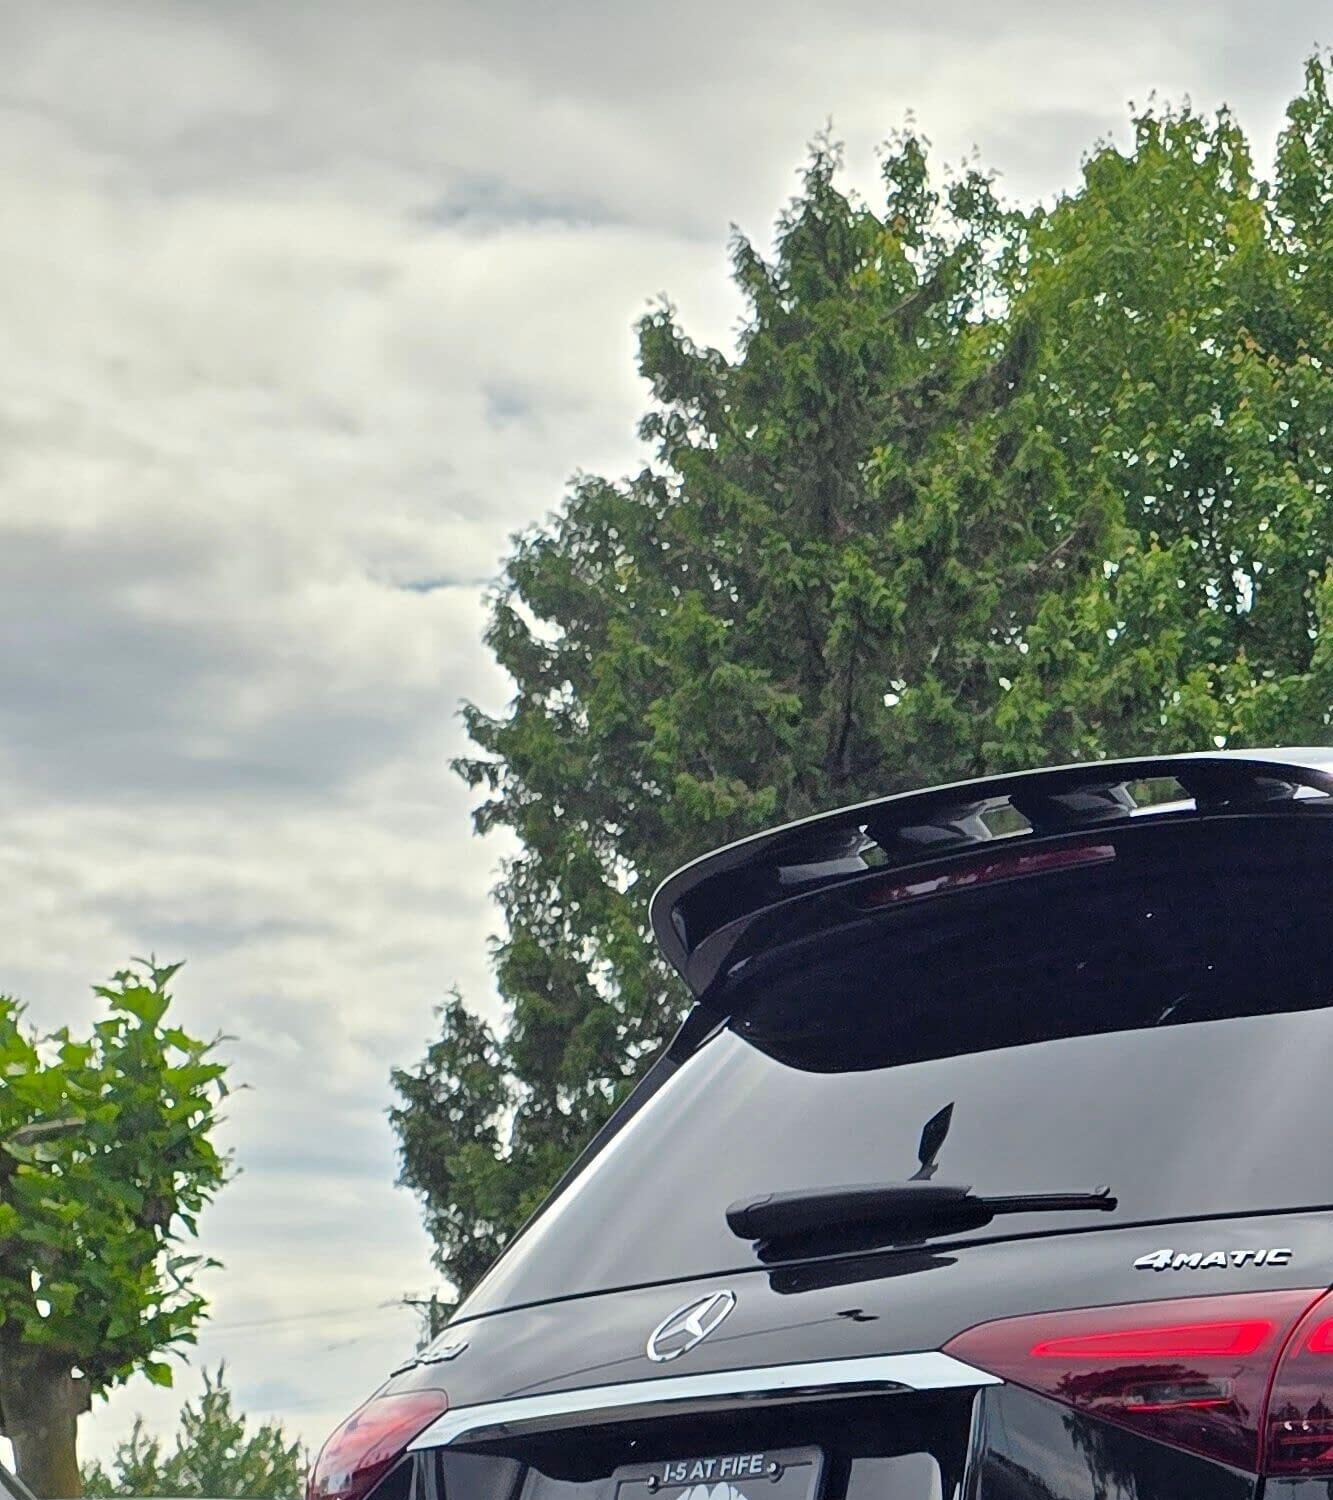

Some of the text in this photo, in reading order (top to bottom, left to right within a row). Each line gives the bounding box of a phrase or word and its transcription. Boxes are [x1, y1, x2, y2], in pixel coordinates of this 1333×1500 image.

[1133, 1248, 1293, 1272] 4MATIC
[663, 1454, 764, 1482] I-5 AT FIFE
